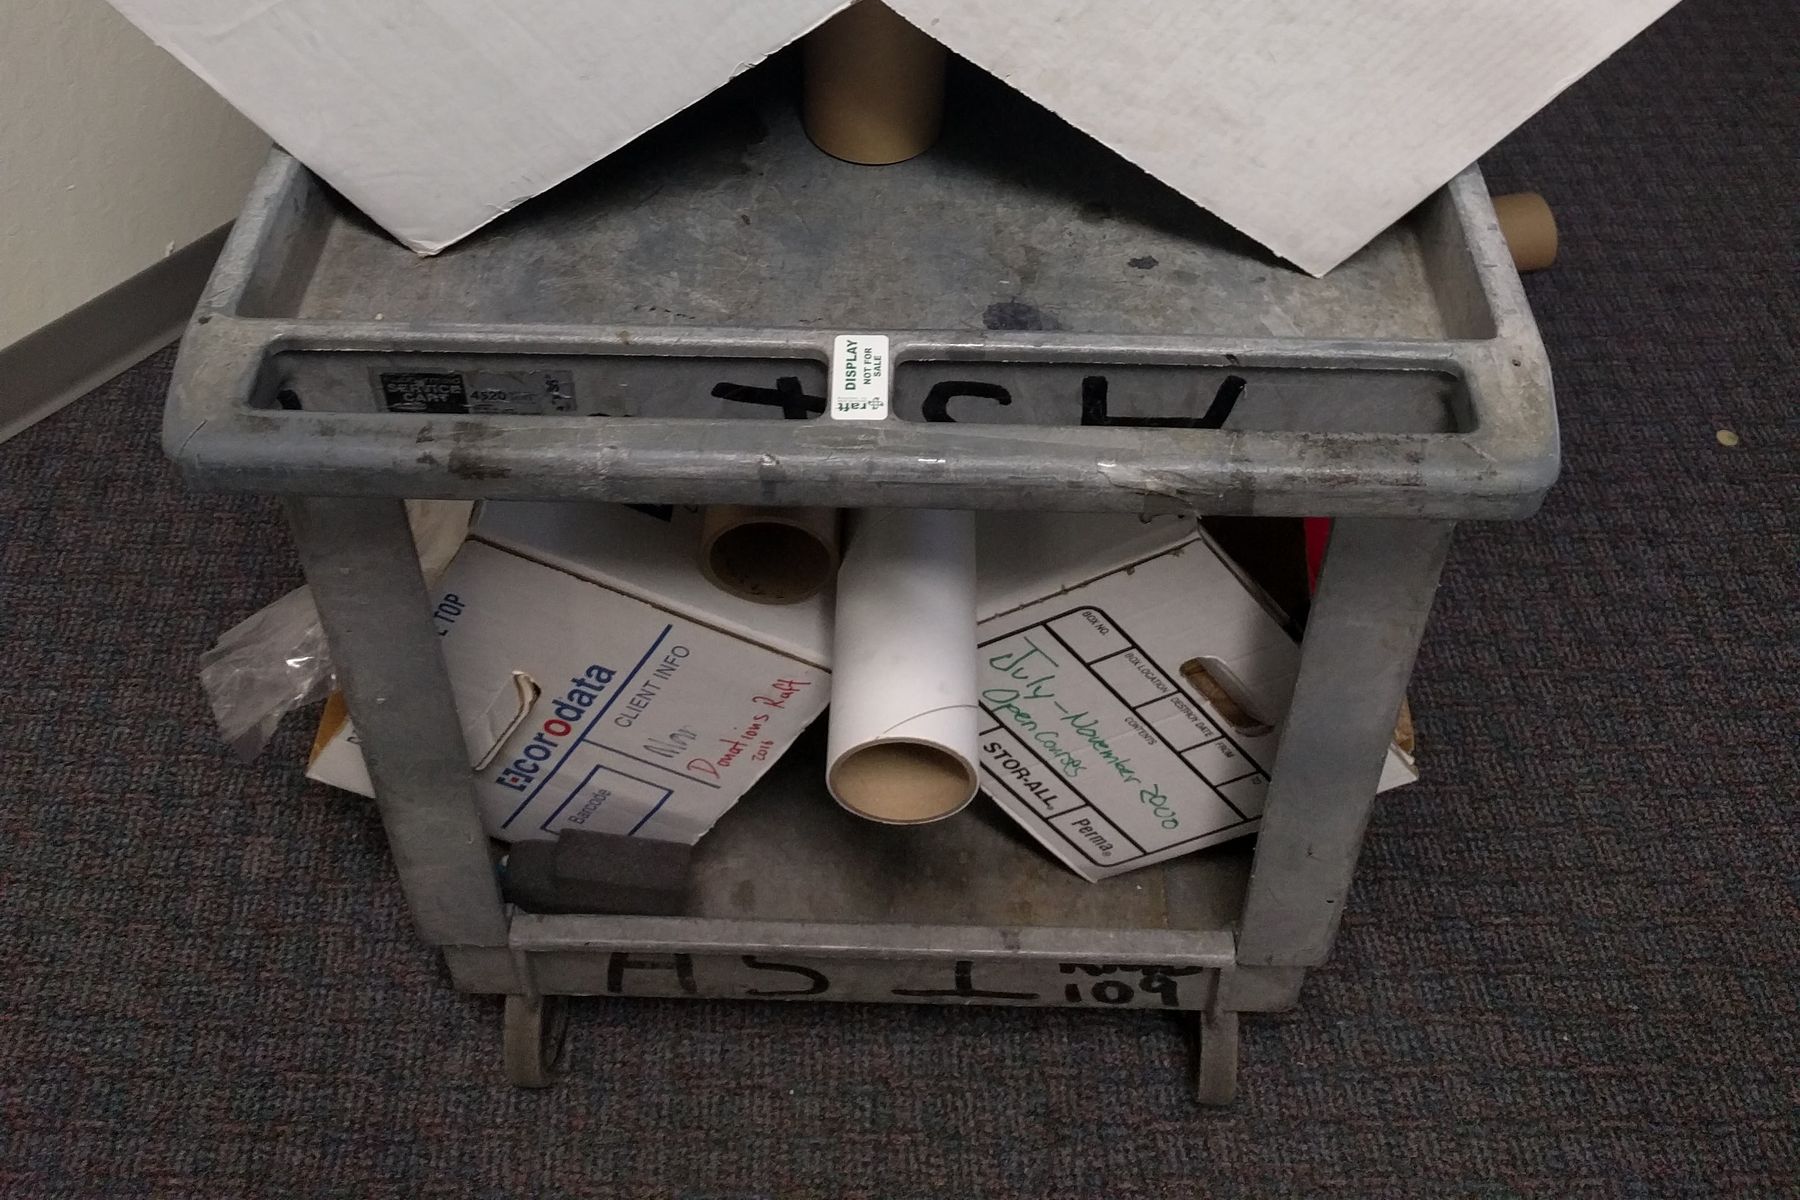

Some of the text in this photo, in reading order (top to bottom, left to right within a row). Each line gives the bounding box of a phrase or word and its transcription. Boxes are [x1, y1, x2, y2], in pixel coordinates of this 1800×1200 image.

[845, 340, 858, 391] DISPLAY
[863, 347, 872, 385] NOT FOR
[873, 355, 881, 377] SALE
[433, 593, 465, 623] TOP
[1082, 611, 1097, 626] BOX
[614, 645, 690, 728] CLIENT INFO
[989, 636, 1059, 699] July
[1124, 652, 1169, 693] BOX LOCATION
[512, 664, 617, 774] corodata
[982, 688, 1037, 731] Open
[1170, 696, 1214, 737] DESTROY DATE
[687, 714, 769, 780] Donations
[1124, 716, 1157, 746] CONTENTS
[1215, 742, 1236, 758] FROM
[568, 789, 612, 825] Barcode
